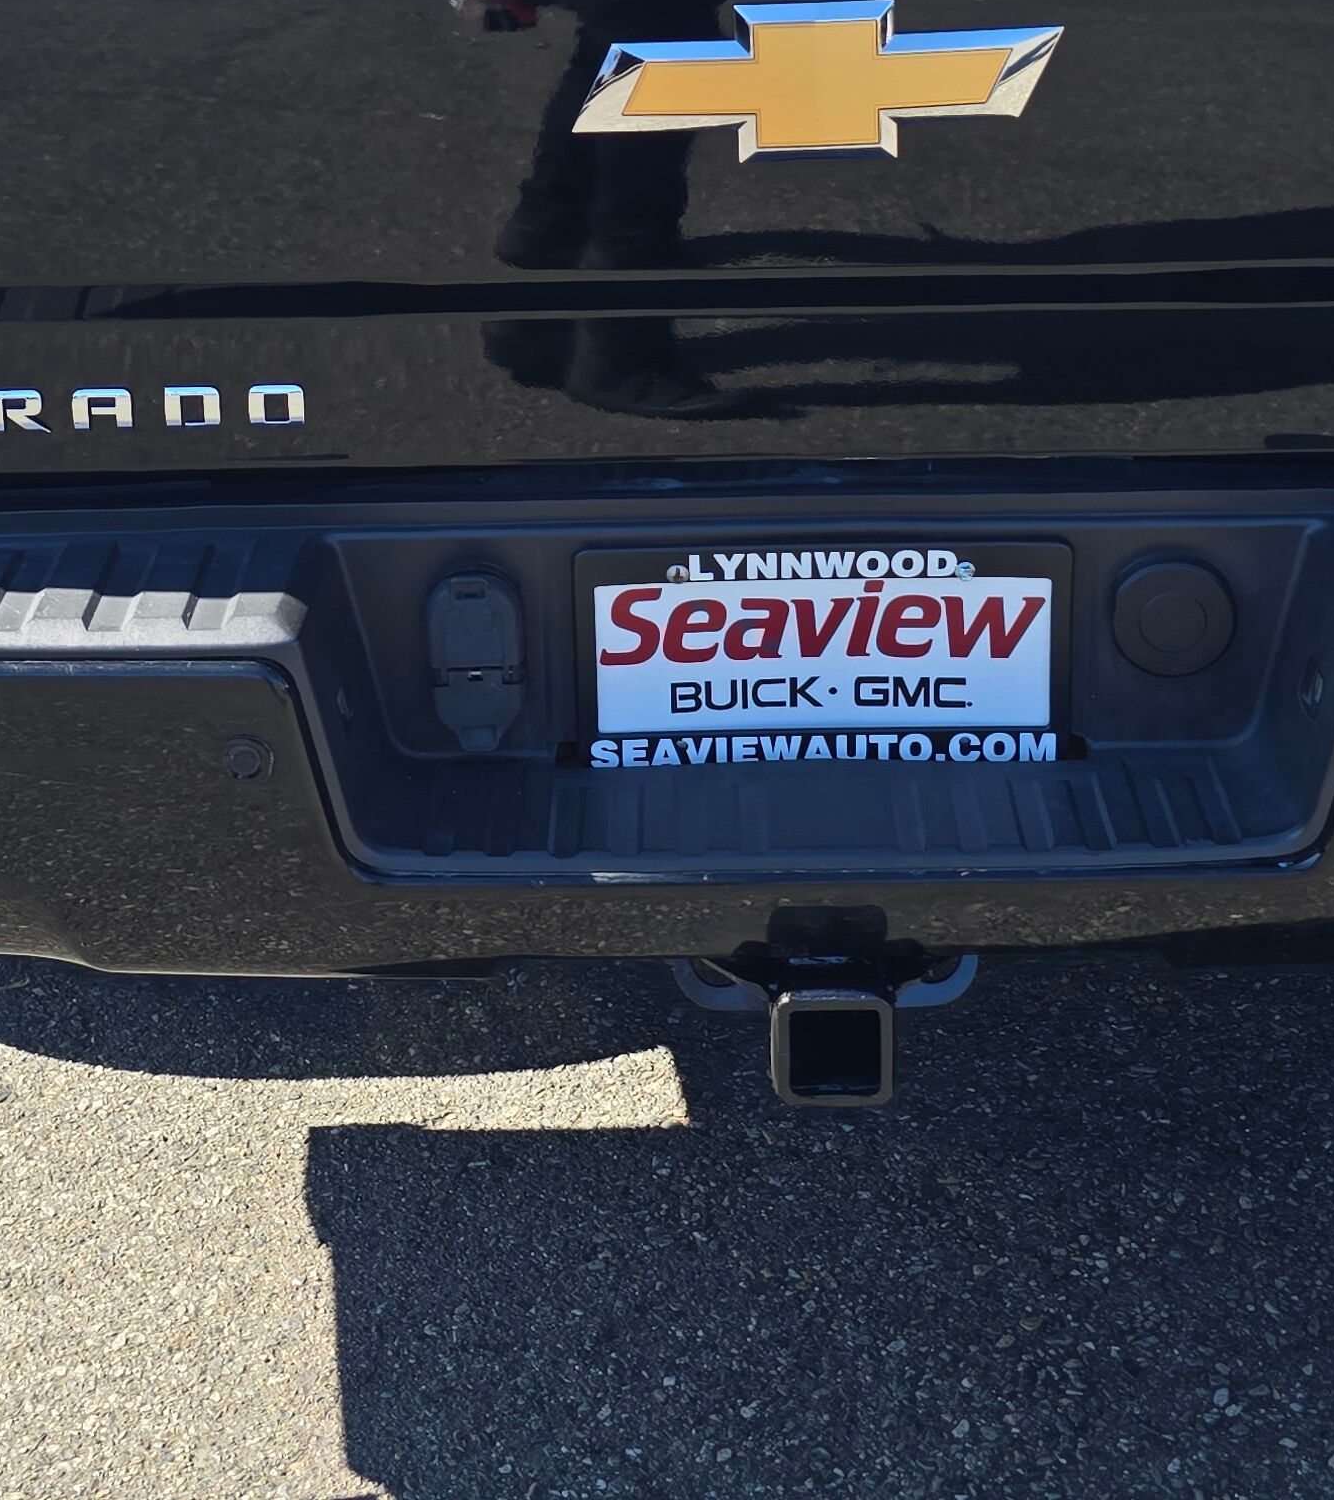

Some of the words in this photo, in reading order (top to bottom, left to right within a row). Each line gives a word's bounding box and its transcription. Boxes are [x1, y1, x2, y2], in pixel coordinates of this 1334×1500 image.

[688, 549, 959, 582] LYNNWOOD
[599, 579, 1047, 667] Seaview
[670, 675, 824, 714] BUICK
[590, 732, 1057, 768] SEAVIEWAUTO.COM
